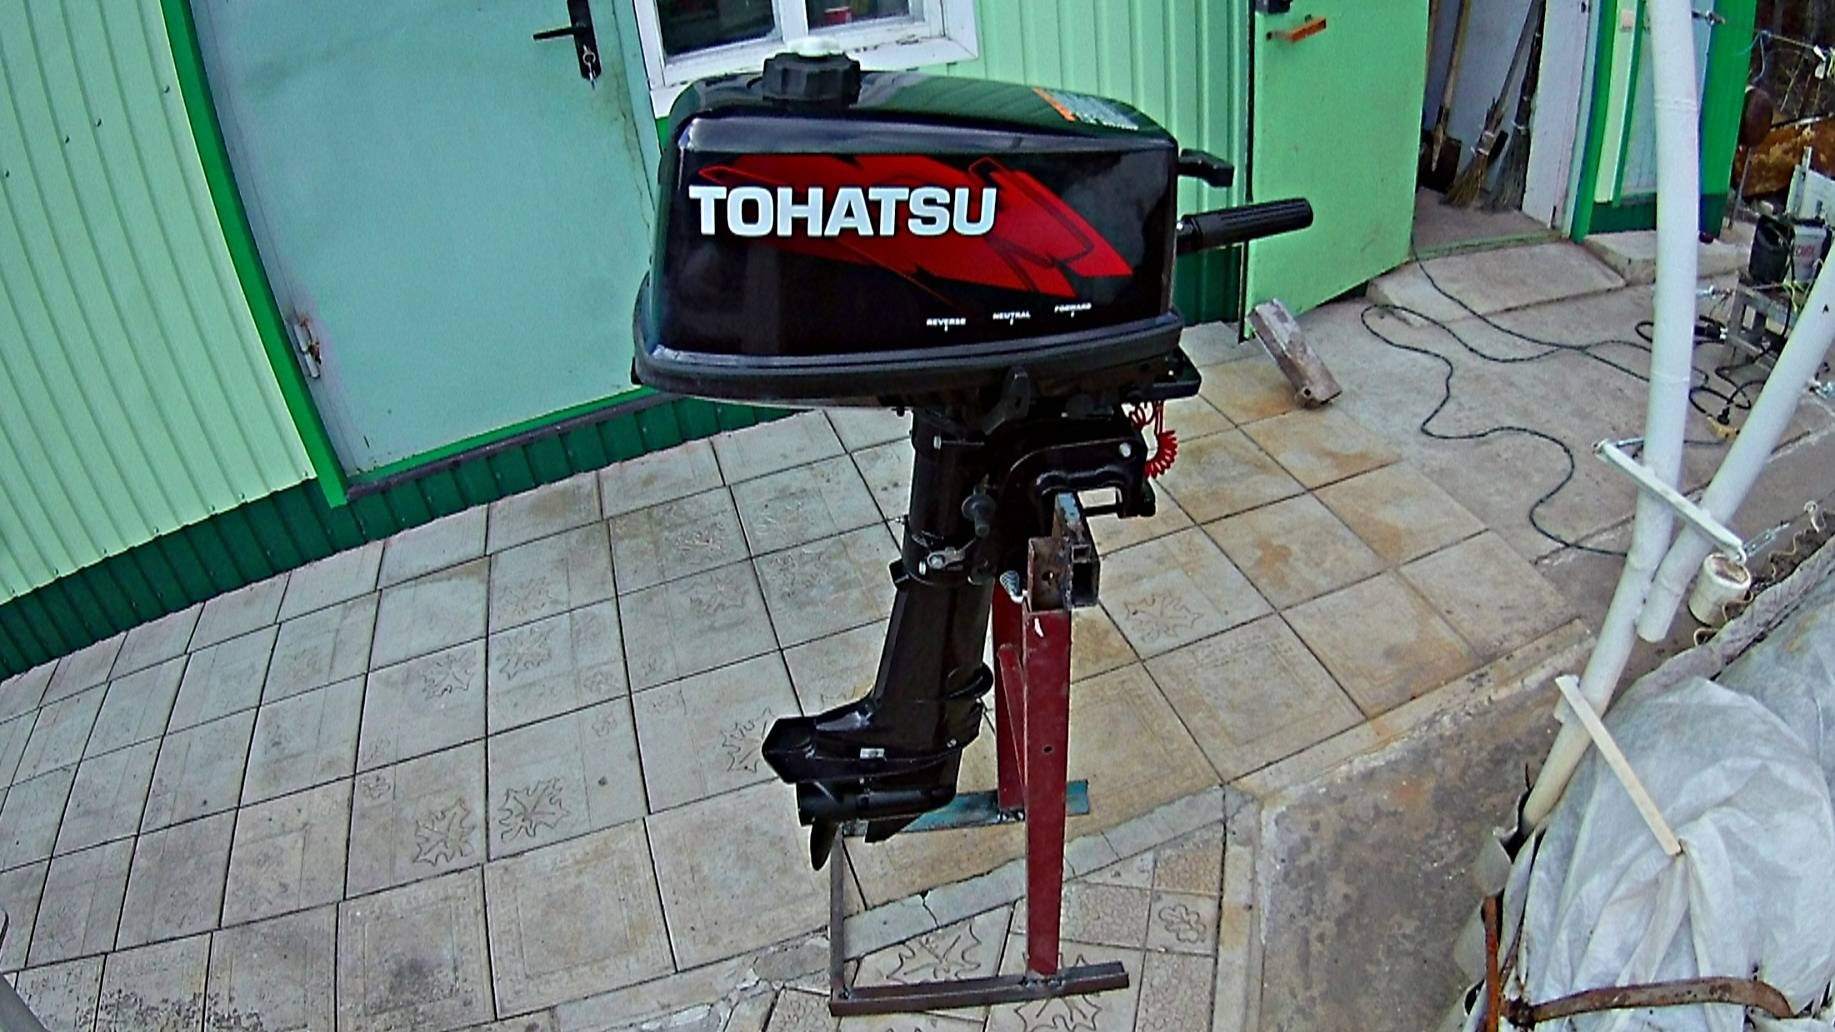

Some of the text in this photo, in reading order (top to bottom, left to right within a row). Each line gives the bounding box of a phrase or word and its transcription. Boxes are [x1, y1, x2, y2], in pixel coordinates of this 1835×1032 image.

[688, 186, 997, 237] TOHATSU
[1054, 302, 1092, 314] FORWARD
[992, 310, 1031, 321] NEUTRAL
[926, 317, 966, 327] REVERSE
